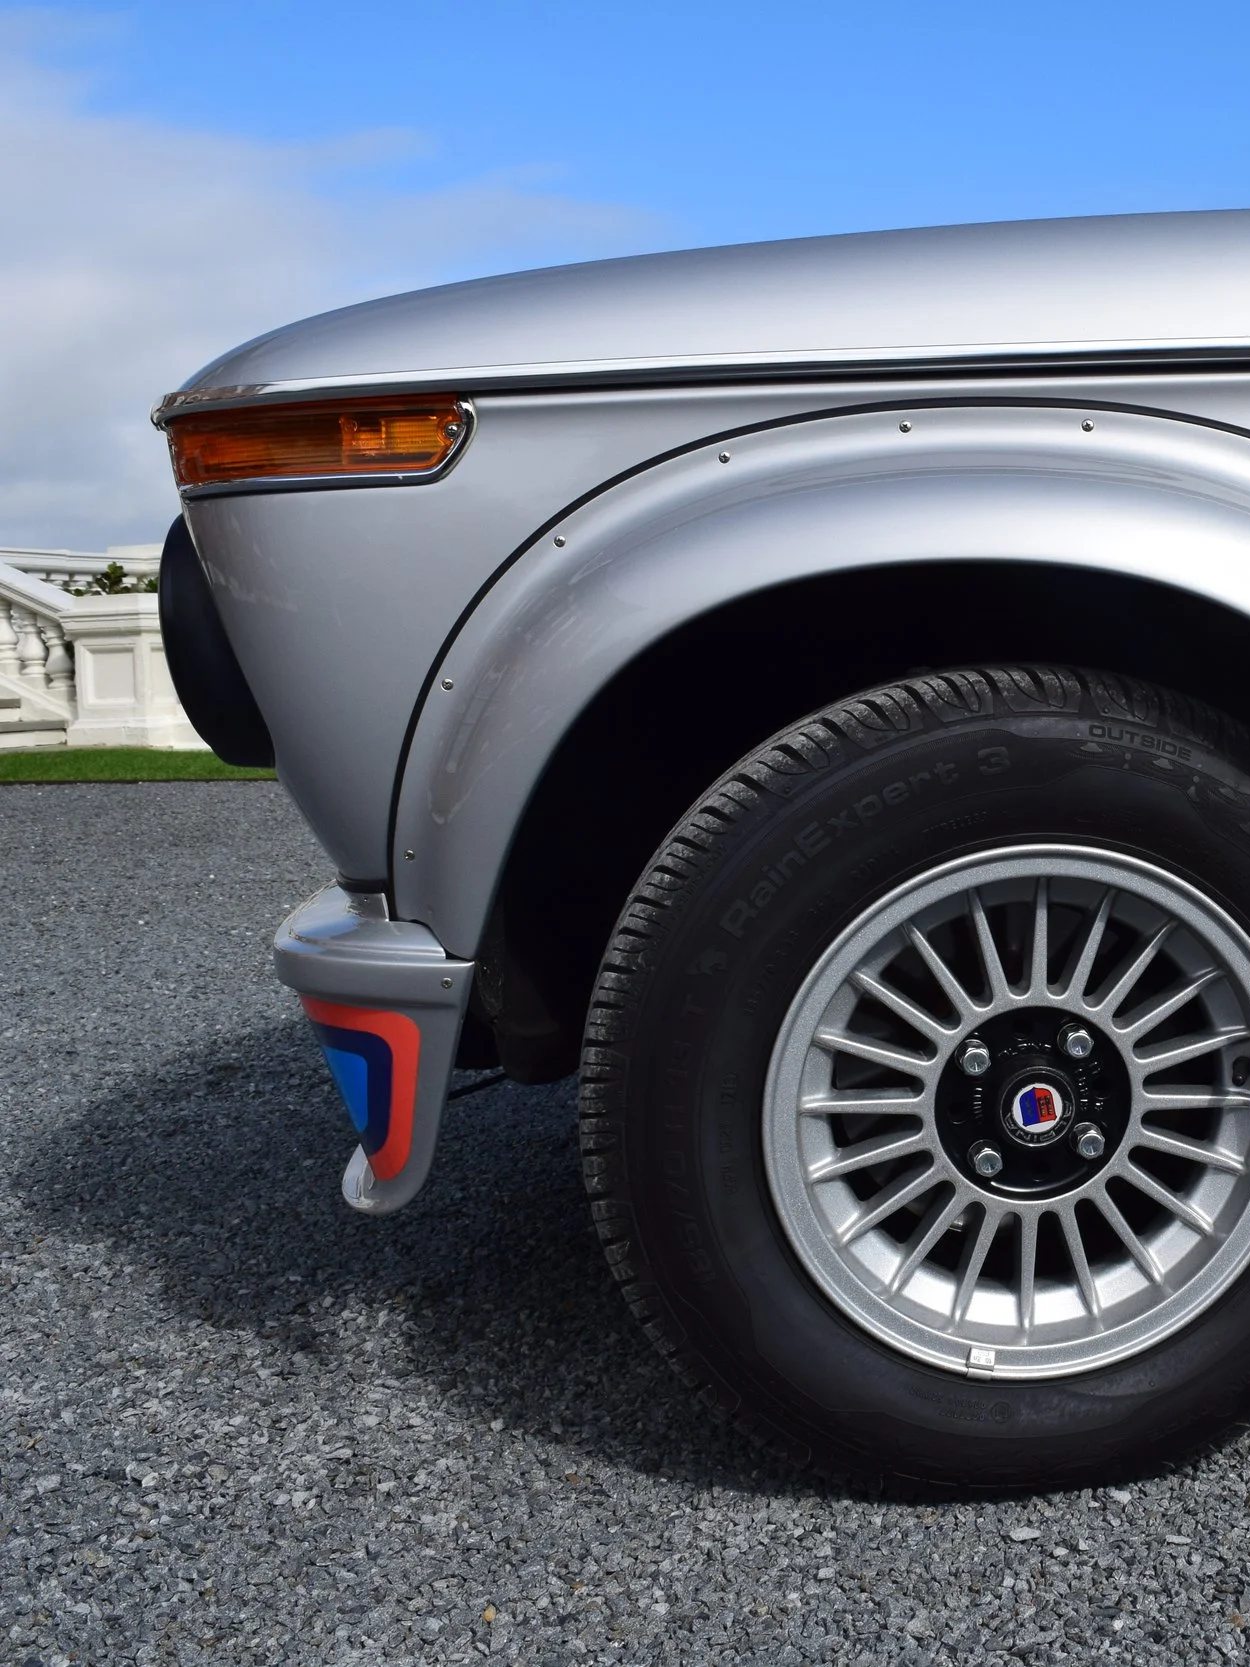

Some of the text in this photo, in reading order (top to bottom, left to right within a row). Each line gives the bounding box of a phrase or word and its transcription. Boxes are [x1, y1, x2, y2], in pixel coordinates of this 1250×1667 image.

[1088, 725, 1192, 761] OUTSIDE
[720, 759, 958, 937] RainExpert
[978, 747, 1010, 775] 3
[1004, 1100, 1072, 1142] ALPINA
